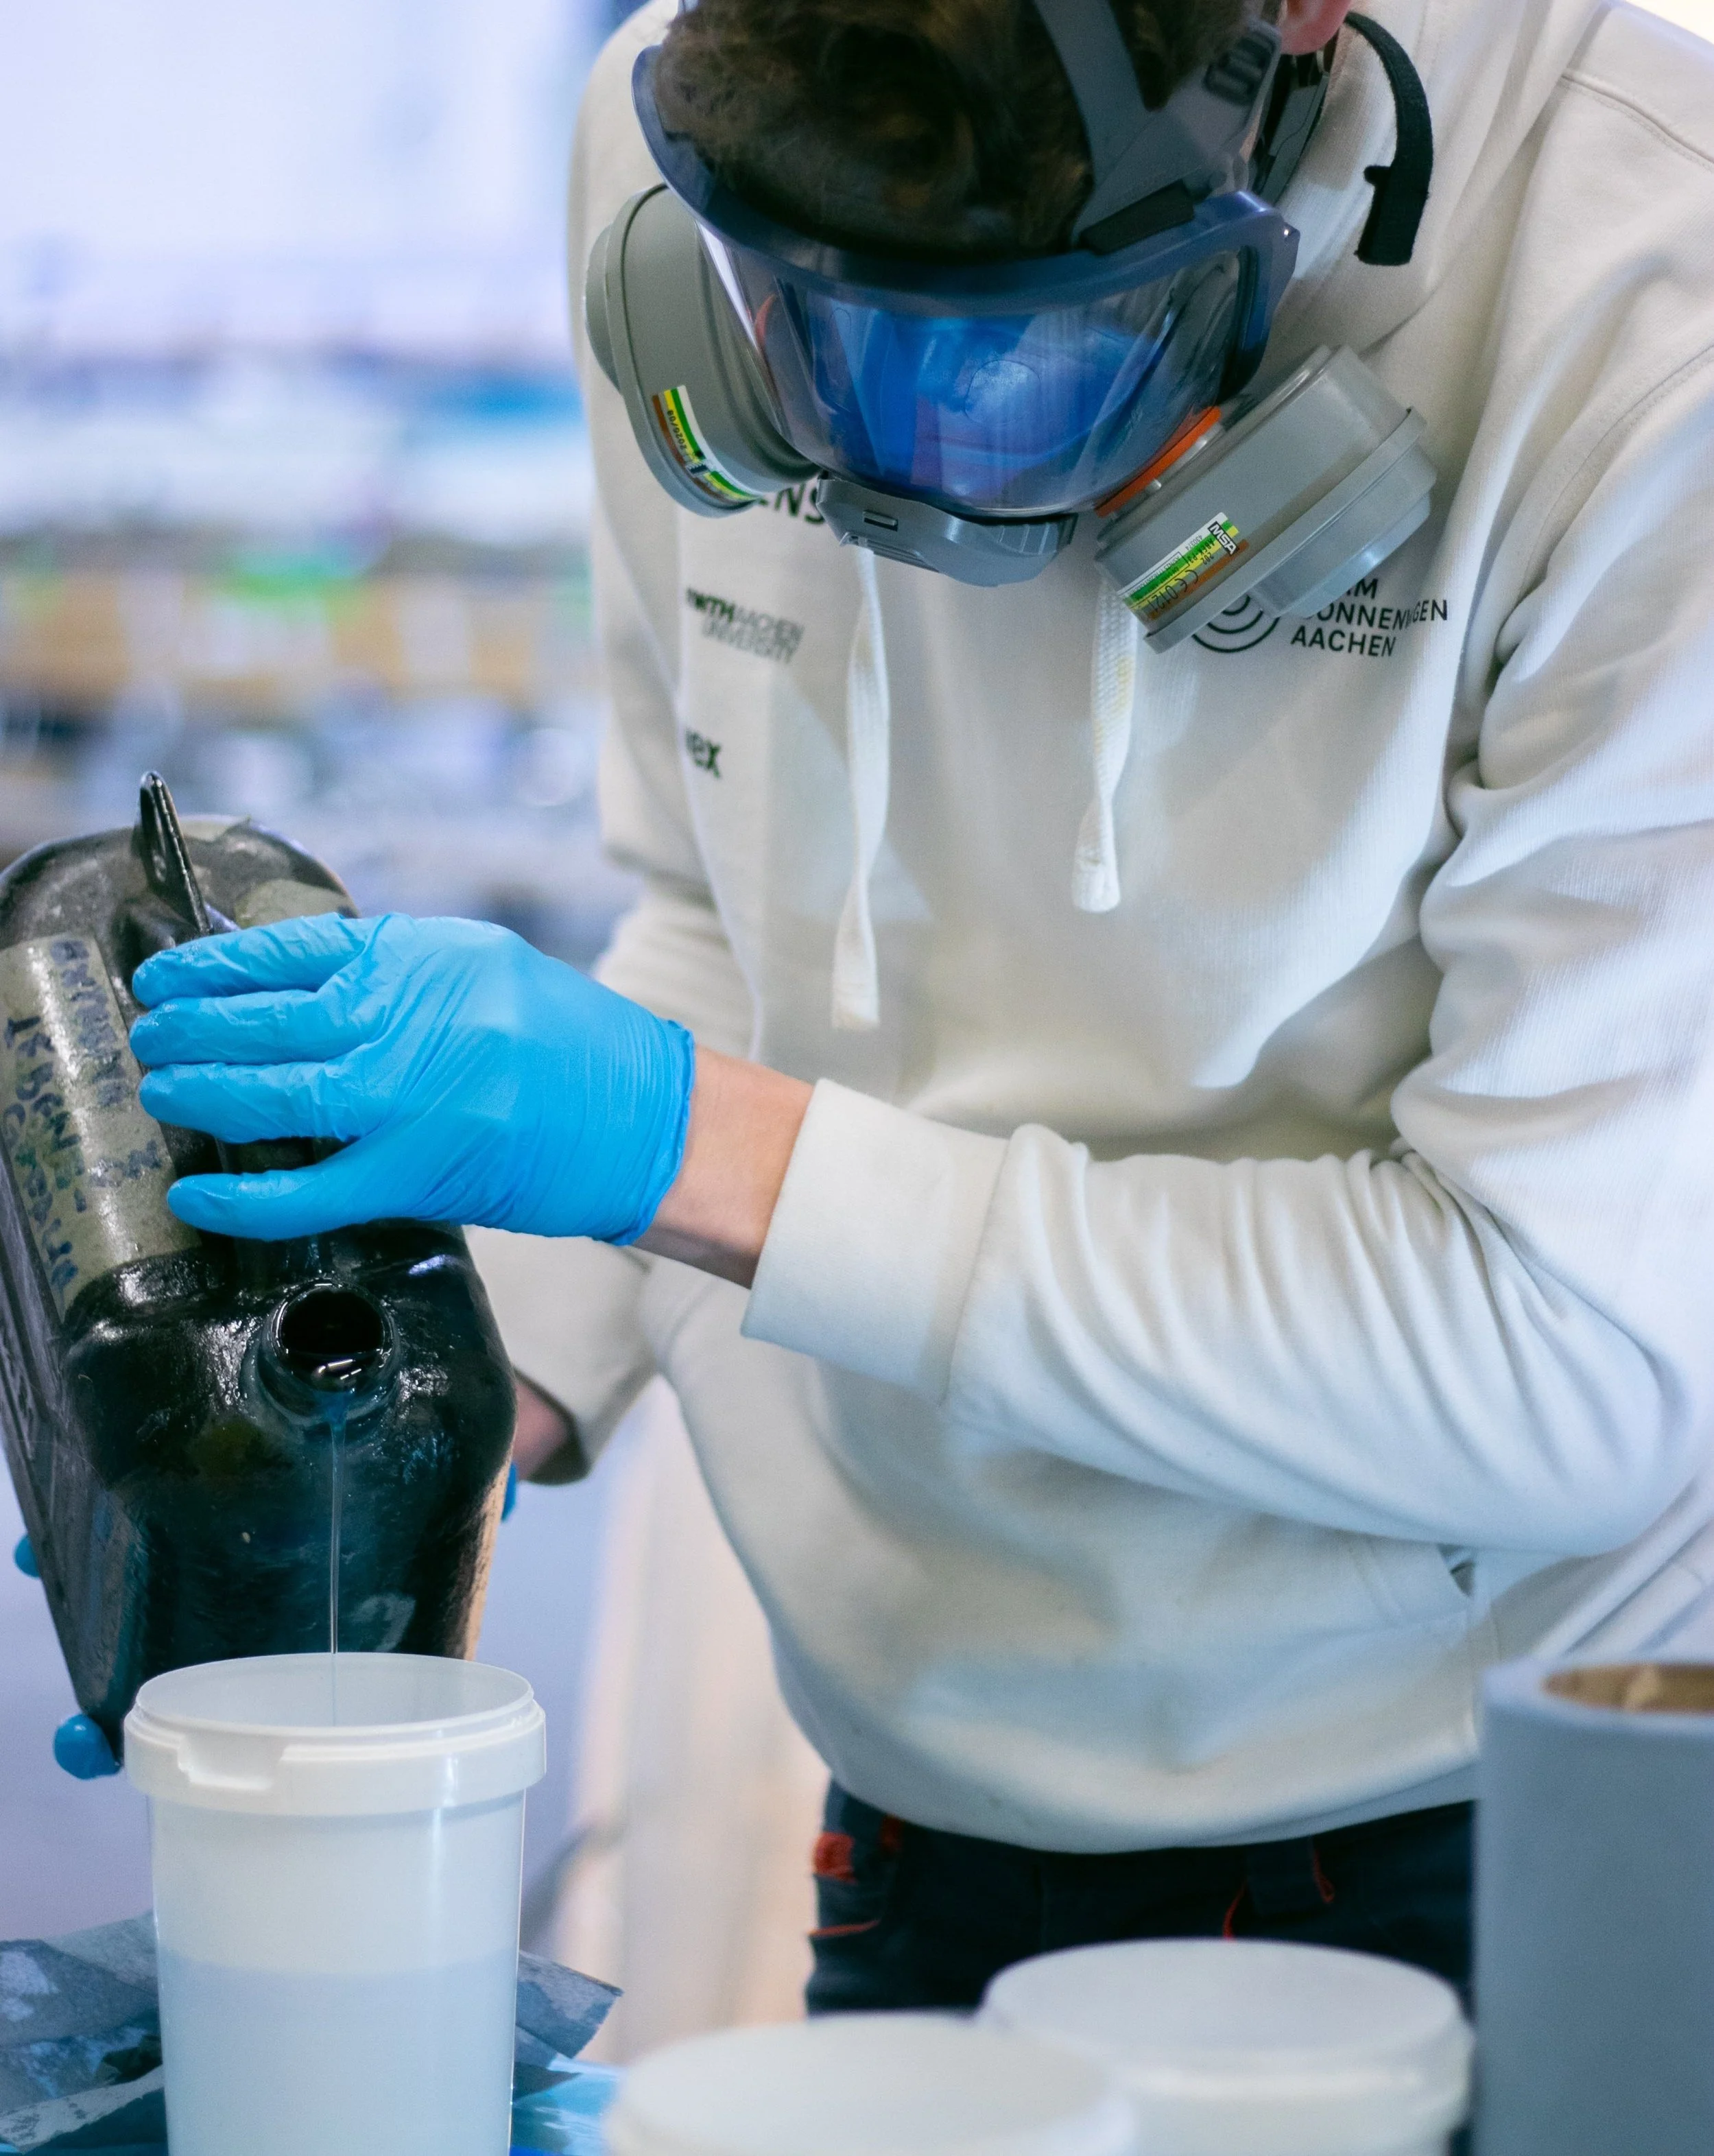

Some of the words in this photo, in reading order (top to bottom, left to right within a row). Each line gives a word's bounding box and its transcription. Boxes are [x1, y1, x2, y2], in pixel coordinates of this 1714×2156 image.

[1209, 523, 1237, 556] MSA
[1147, 585, 1178, 612] 0121
[1291, 625, 1396, 656] AACHEN
